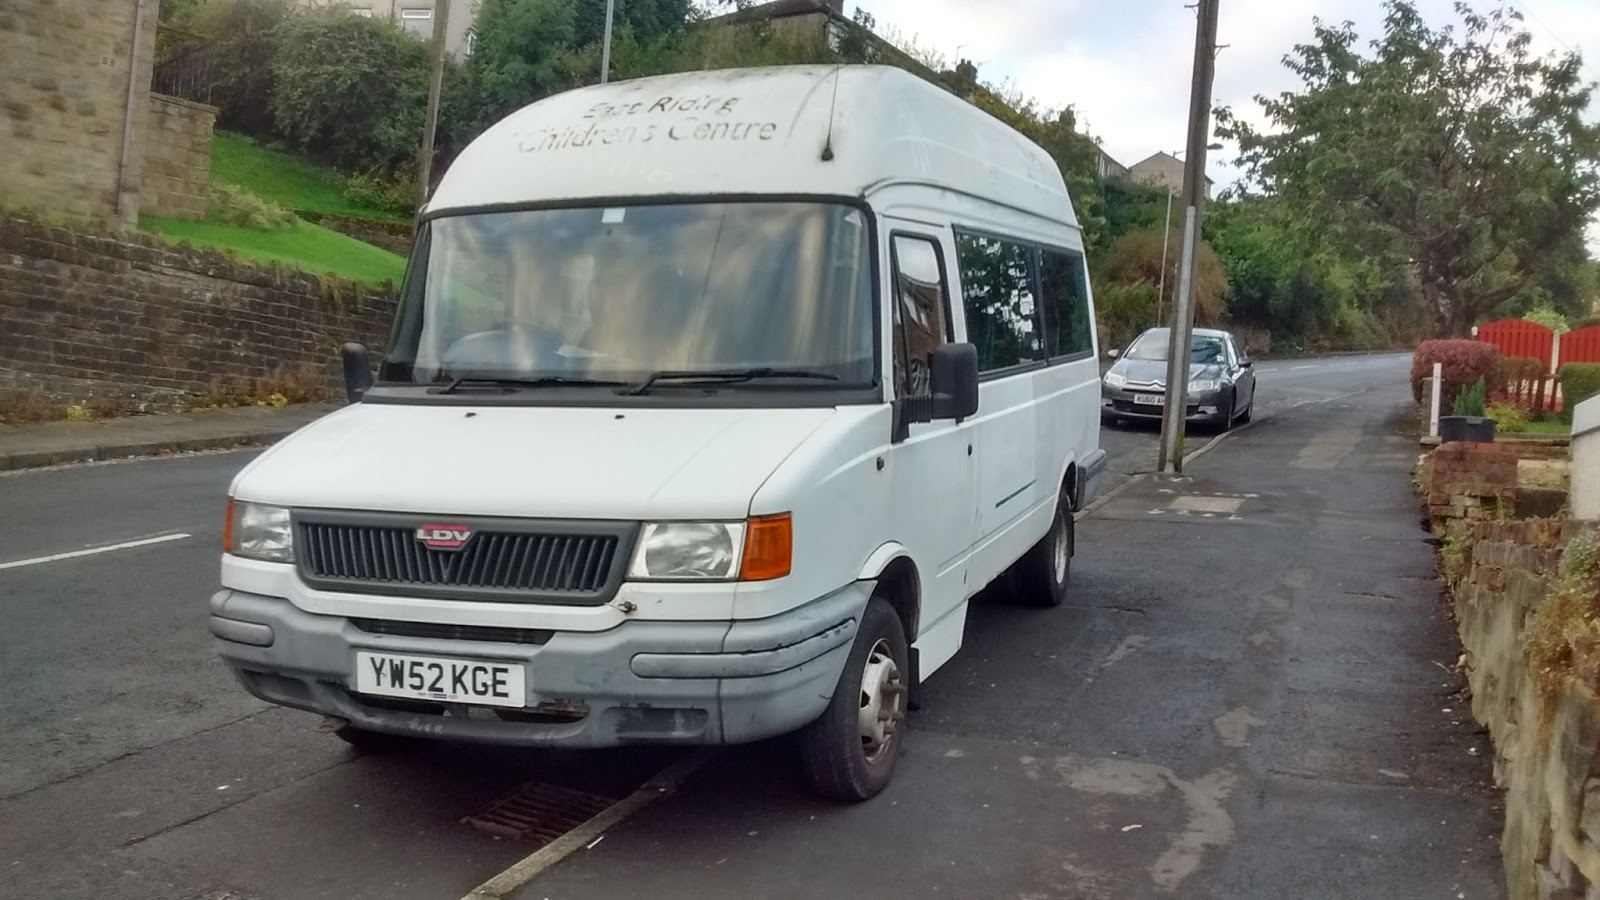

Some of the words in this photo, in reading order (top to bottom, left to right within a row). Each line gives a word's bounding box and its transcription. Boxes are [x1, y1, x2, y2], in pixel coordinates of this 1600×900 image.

[416, 528, 472, 542] LDV
[370, 657, 444, 693] YW52
[452, 664, 509, 698] KGE
